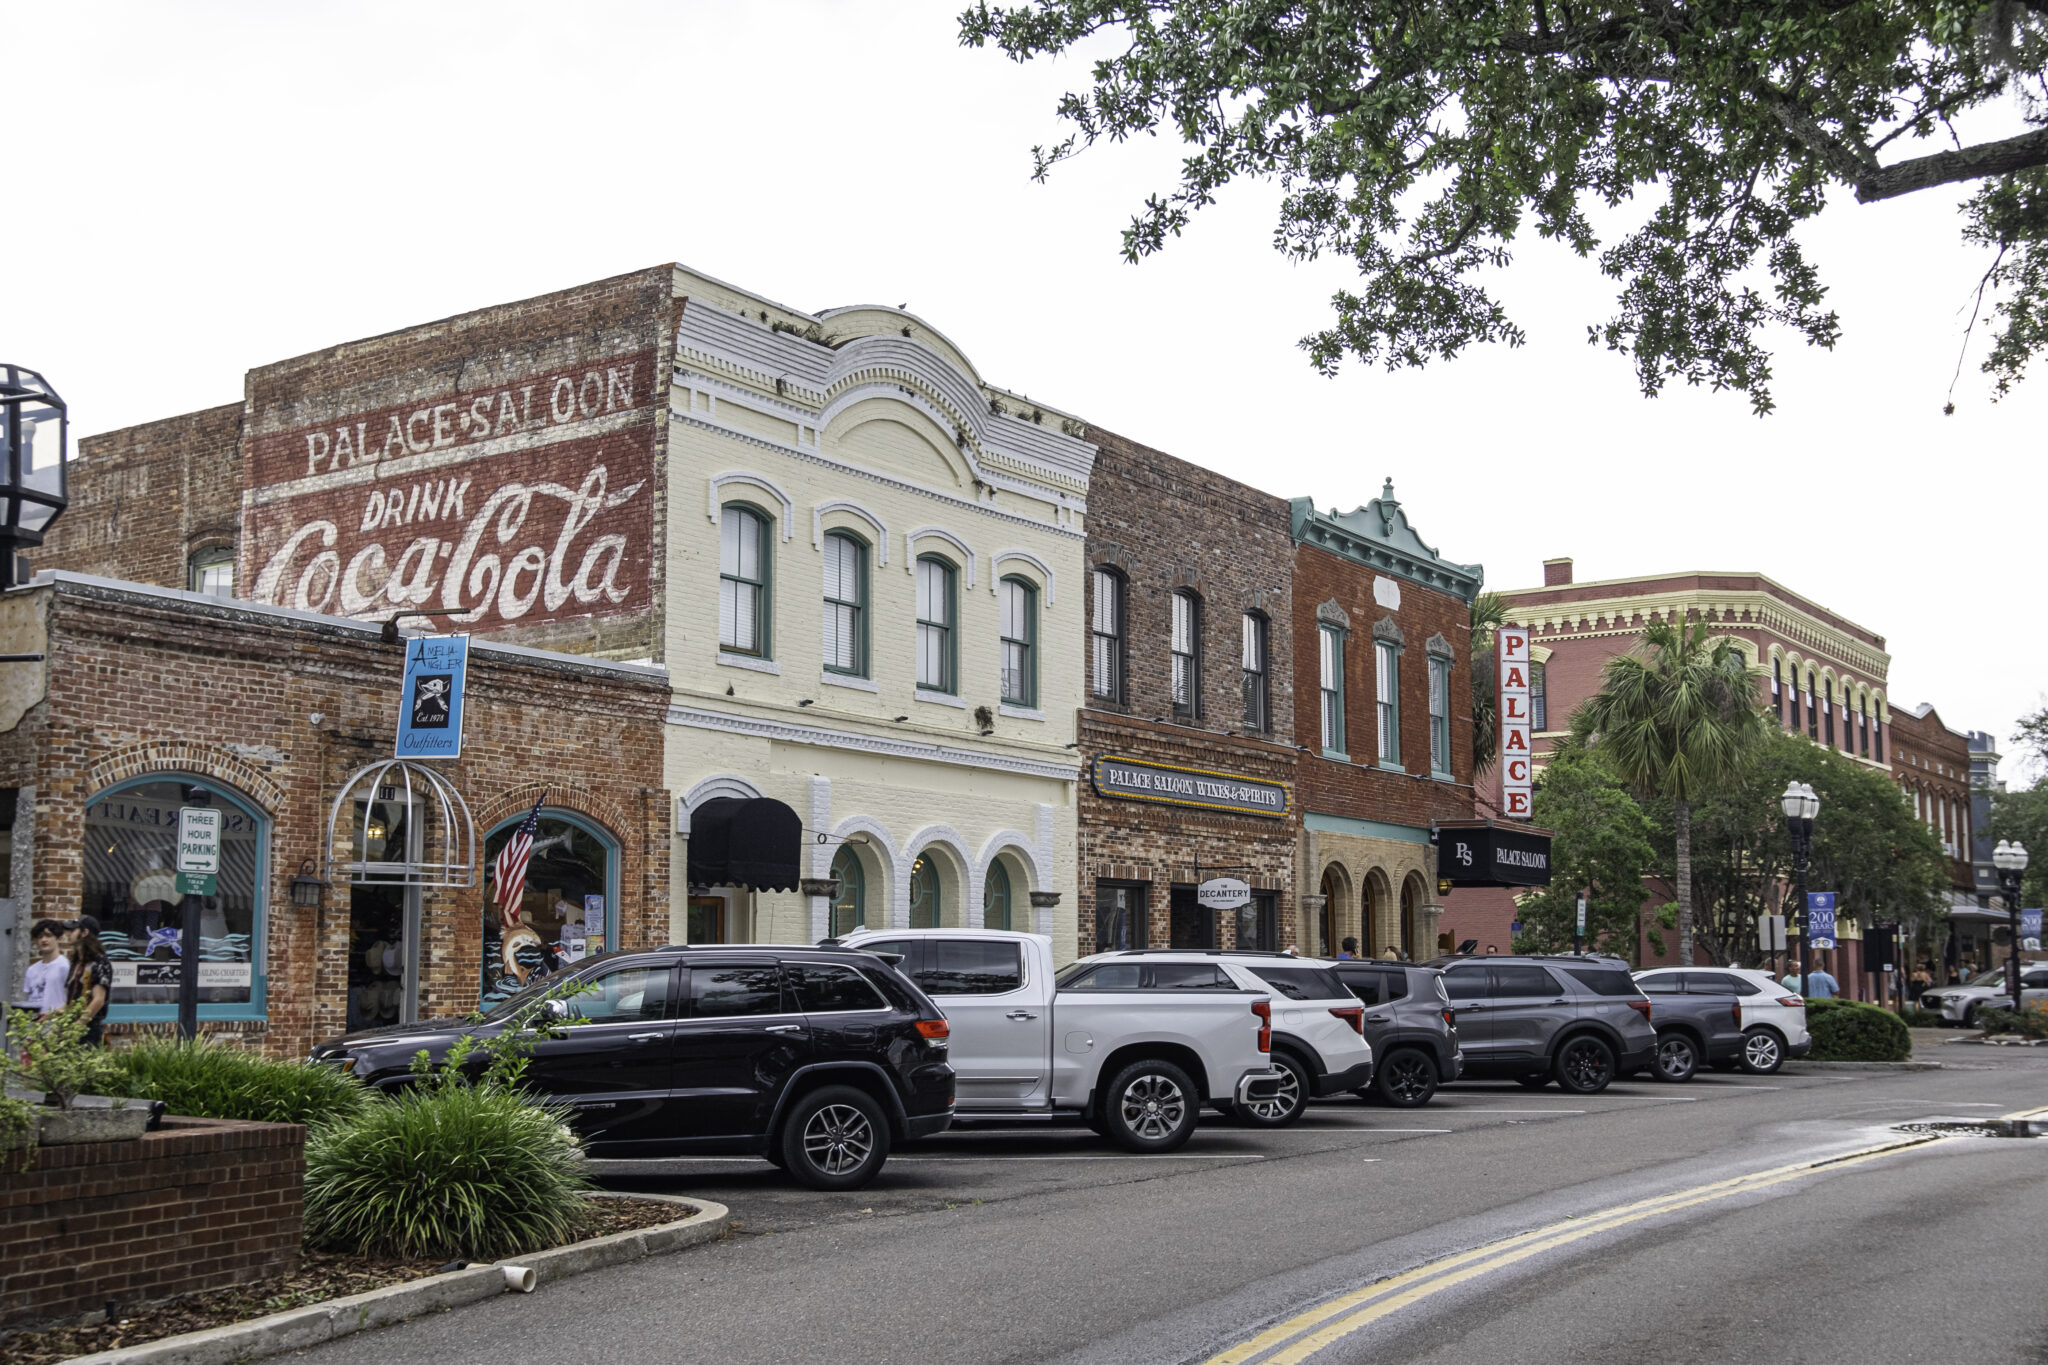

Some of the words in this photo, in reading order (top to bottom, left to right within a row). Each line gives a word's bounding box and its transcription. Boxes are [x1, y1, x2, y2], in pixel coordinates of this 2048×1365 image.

[305, 402, 458, 475] PALACE
[469, 362, 636, 439] SALOON
[360, 476, 472, 532] DRINK
[1504, 635, 1529, 814] PALACE
[403, 732, 454, 753] Outfitters
[1109, 769, 1151, 789] PALACE
[1154, 775, 1193, 795] SALOON
[187, 815, 215, 826] THREE
[187, 830, 212, 840] HOUR
[182, 843, 217, 856] PARKING
[1496, 847, 1521, 866] PALACE
[1521, 851, 1547, 869] SALOON
[1199, 889, 1249, 898] DECANTERY
[1808, 911, 1835, 924] 200
[1810, 922, 1834, 930] YEARS
